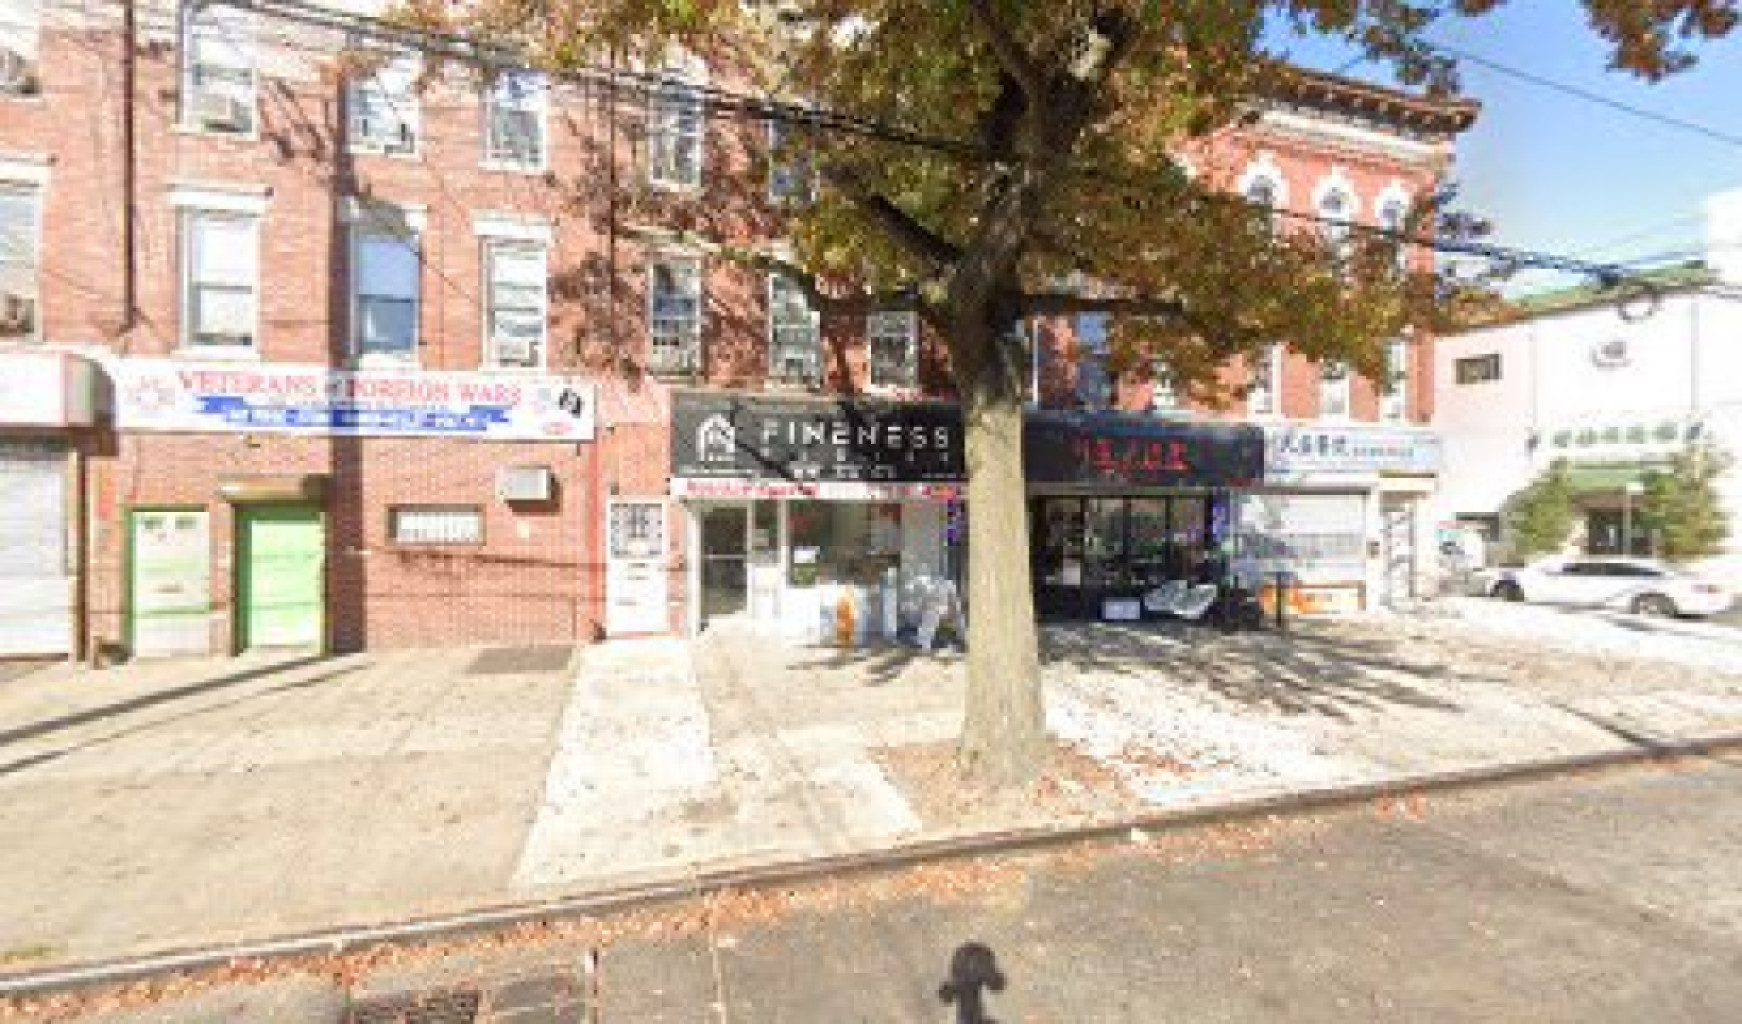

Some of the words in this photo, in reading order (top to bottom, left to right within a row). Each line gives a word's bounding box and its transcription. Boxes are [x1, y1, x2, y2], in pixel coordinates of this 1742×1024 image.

[177, 371, 317, 396] VETERANS
[346, 377, 450, 402] FOREIGN
[458, 382, 521, 406] WARS
[762, 421, 949, 448] FINENESS
